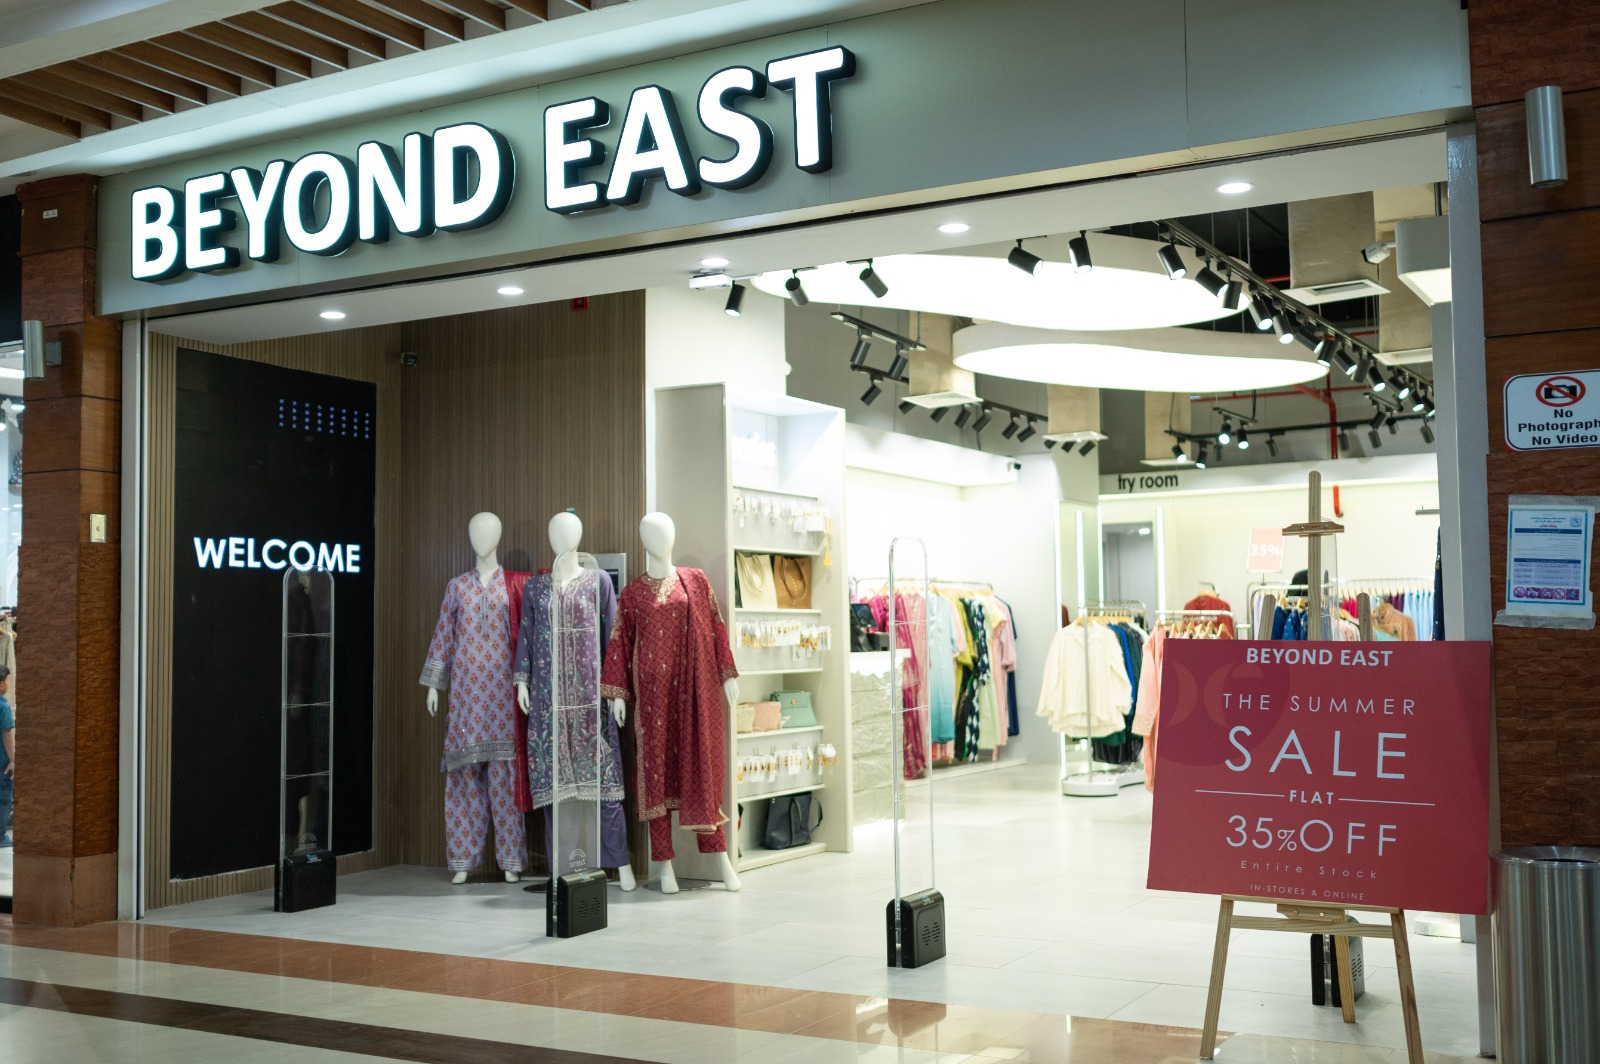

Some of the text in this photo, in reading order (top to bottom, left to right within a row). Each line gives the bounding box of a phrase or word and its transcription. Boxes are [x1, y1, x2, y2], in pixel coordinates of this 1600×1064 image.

[131, 45, 856, 281] BEYOND EAST
[1553, 409, 1573, 418] No
[1532, 434, 1598, 445] No Video
[1117, 474, 1179, 493] try room
[193, 536, 361, 573] WELCOME
[1250, 543, 1282, 556] 35%
[1246, 647, 1393, 667] BEYOND EAST
[1223, 693, 1415, 715] THE SUMMER
[1224, 725, 1407, 780] SALE
[1289, 789, 1334, 805] FLAT
[1240, 860, 1376, 879] Entire Stock
[1250, 884, 1365, 901] IN-STORES & ONLINE
